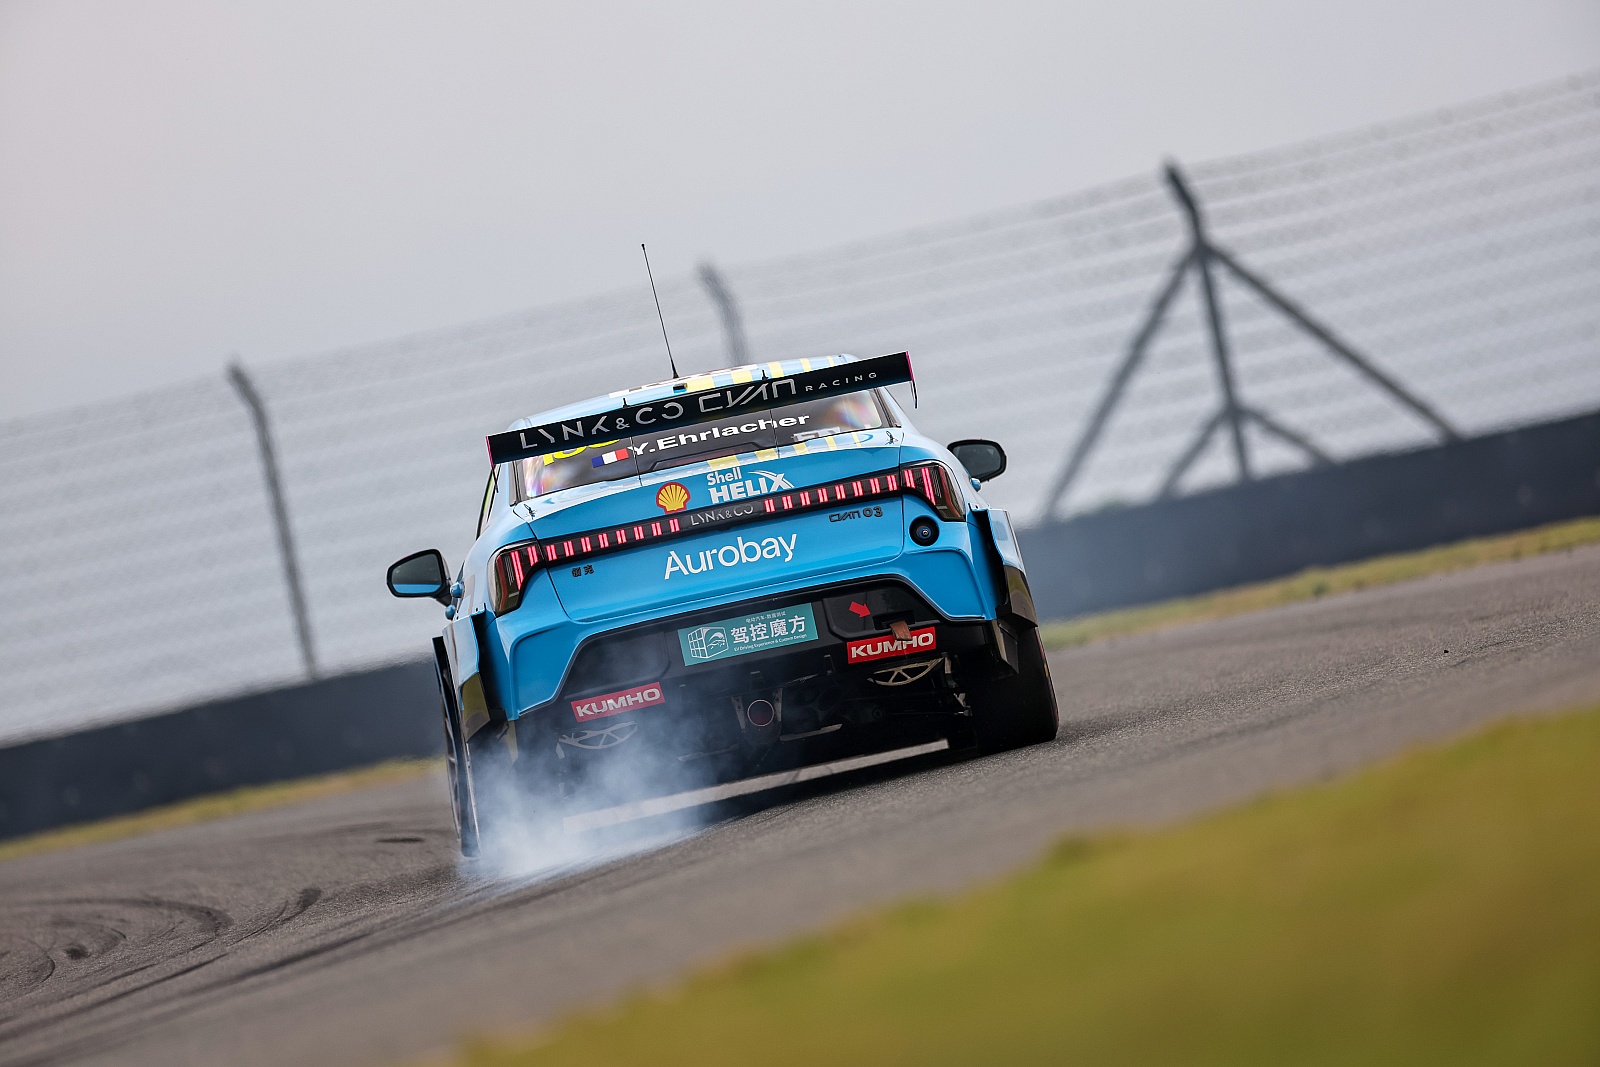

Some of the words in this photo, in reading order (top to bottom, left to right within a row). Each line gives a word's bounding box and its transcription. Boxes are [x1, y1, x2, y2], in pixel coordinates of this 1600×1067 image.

[804, 372, 878, 392] RACING
[627, 414, 811, 456] Y.Ehrlacher
[706, 466, 743, 486] Shell
[708, 469, 795, 505] HELIX
[862, 505, 884, 518] 03
[664, 533, 798, 580] Aurobay
[731, 615, 805, 644] 驾控魔方
[851, 632, 934, 659] KUMHO
[576, 687, 661, 717] KUMHO
